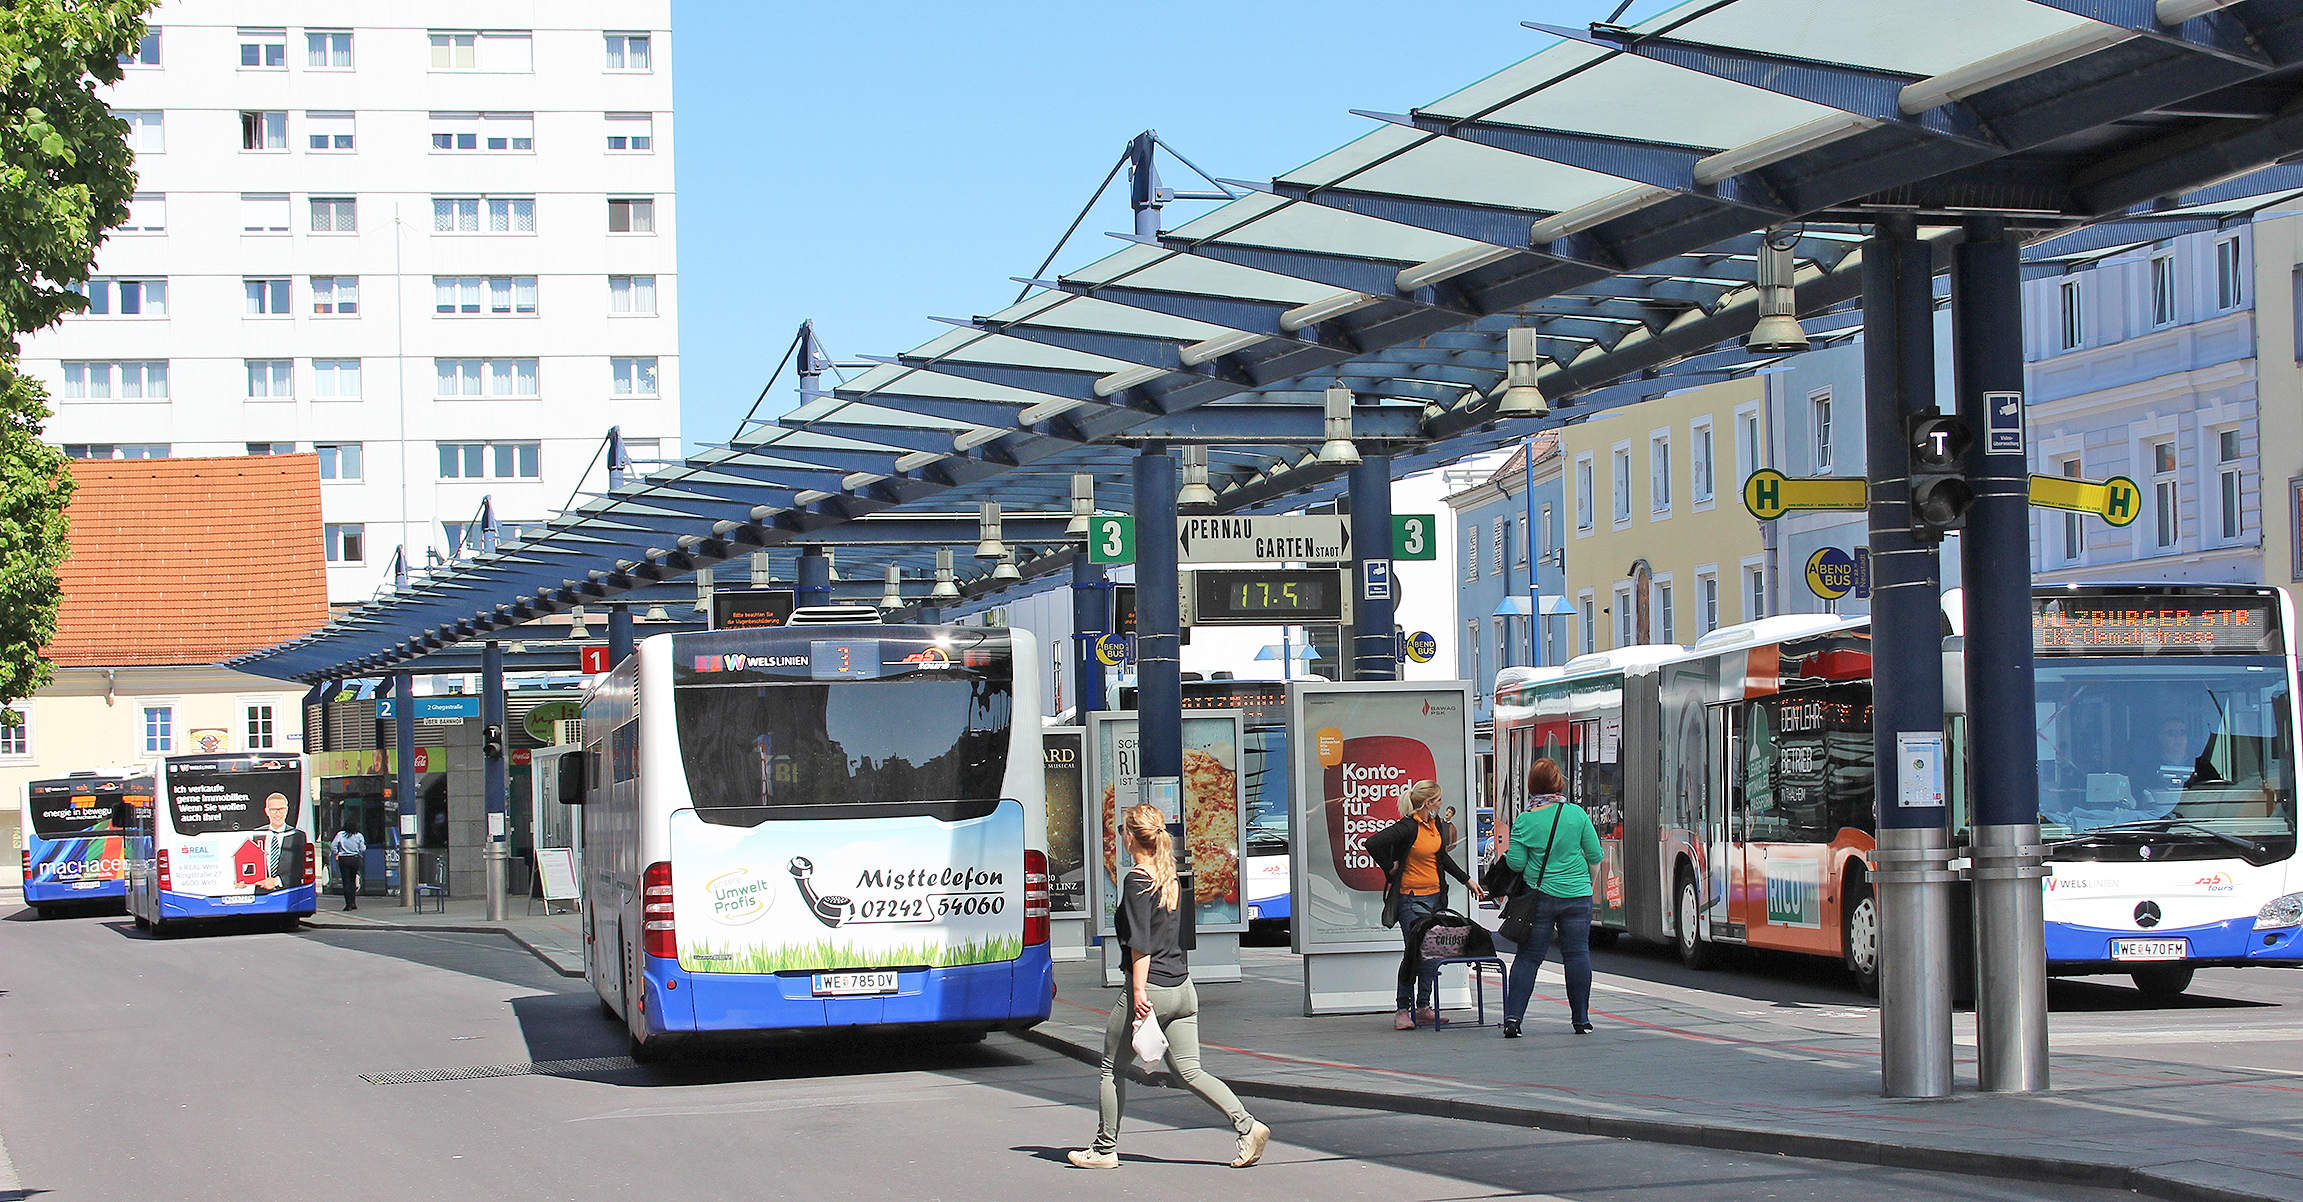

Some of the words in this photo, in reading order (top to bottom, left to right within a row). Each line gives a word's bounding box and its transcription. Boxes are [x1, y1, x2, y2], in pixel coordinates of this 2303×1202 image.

[1756, 479, 1779, 509] H
[2108, 486, 2131, 517] H
[1191, 518, 1252, 540] PERNAU
[1403, 518, 1424, 554] 3
[1102, 520, 1123, 557] 3
[1808, 562, 1852, 575] ABEND
[1825, 575, 1851, 586] BUS
[2201, 609, 2257, 627] STR.
[1107, 650, 1125, 658] BUS
[1418, 647, 1434, 655] BUS
[589, 651, 600, 671] 1
[381, 702, 392, 716] 2
[439, 717, 463, 725] BAHNHOF
[1342, 763, 1407, 780] Konto-
[173, 785, 187, 793] Ich
[188, 784, 225, 793] verkaufe
[1119, 778, 1134, 786] IST
[1342, 779, 1412, 802] Upgrad
[176, 795, 201, 804] gerne
[179, 804, 203, 813] Wenn
[203, 804, 218, 812] Sie
[218, 803, 247, 811] wollen
[1342, 798, 1371, 815] für
[43, 808, 72, 818] energie
[82, 807, 112, 817] bewegu
[180, 814, 202, 822] auch
[856, 867, 1004, 891] Misttelefon
[1055, 882, 1077, 890] LINZ
[716, 879, 767, 901] Umwelt
[714, 896, 756, 914] Profis
[861, 900, 922, 918] 07242
[937, 896, 1005, 916] 54060
